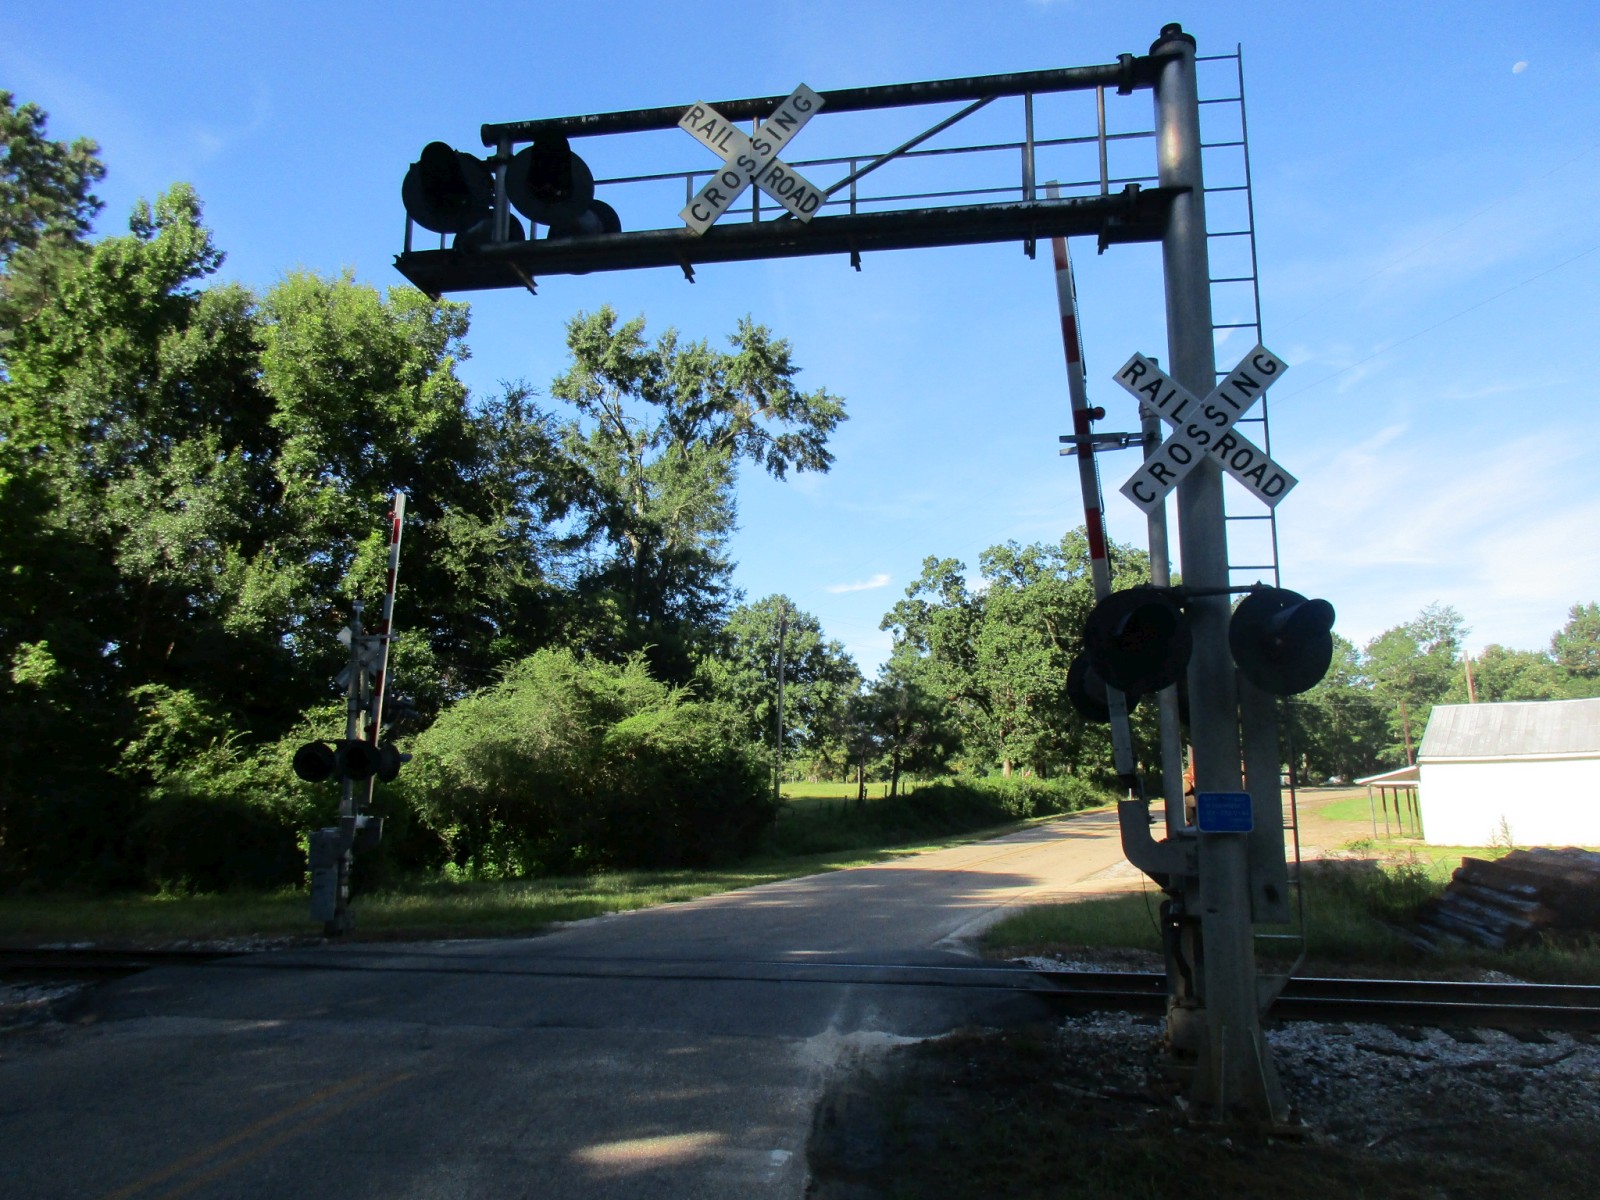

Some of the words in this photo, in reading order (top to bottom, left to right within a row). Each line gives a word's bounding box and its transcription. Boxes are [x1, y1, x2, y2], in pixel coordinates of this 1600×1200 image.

[684, 105, 733, 153] RAIL
[763, 166, 819, 214] ROAD
[691, 95, 812, 222] CROSSING
[1121, 359, 1189, 425] RAIL
[1211, 432, 1286, 498] ROAD
[1131, 353, 1277, 504] CROSSING
